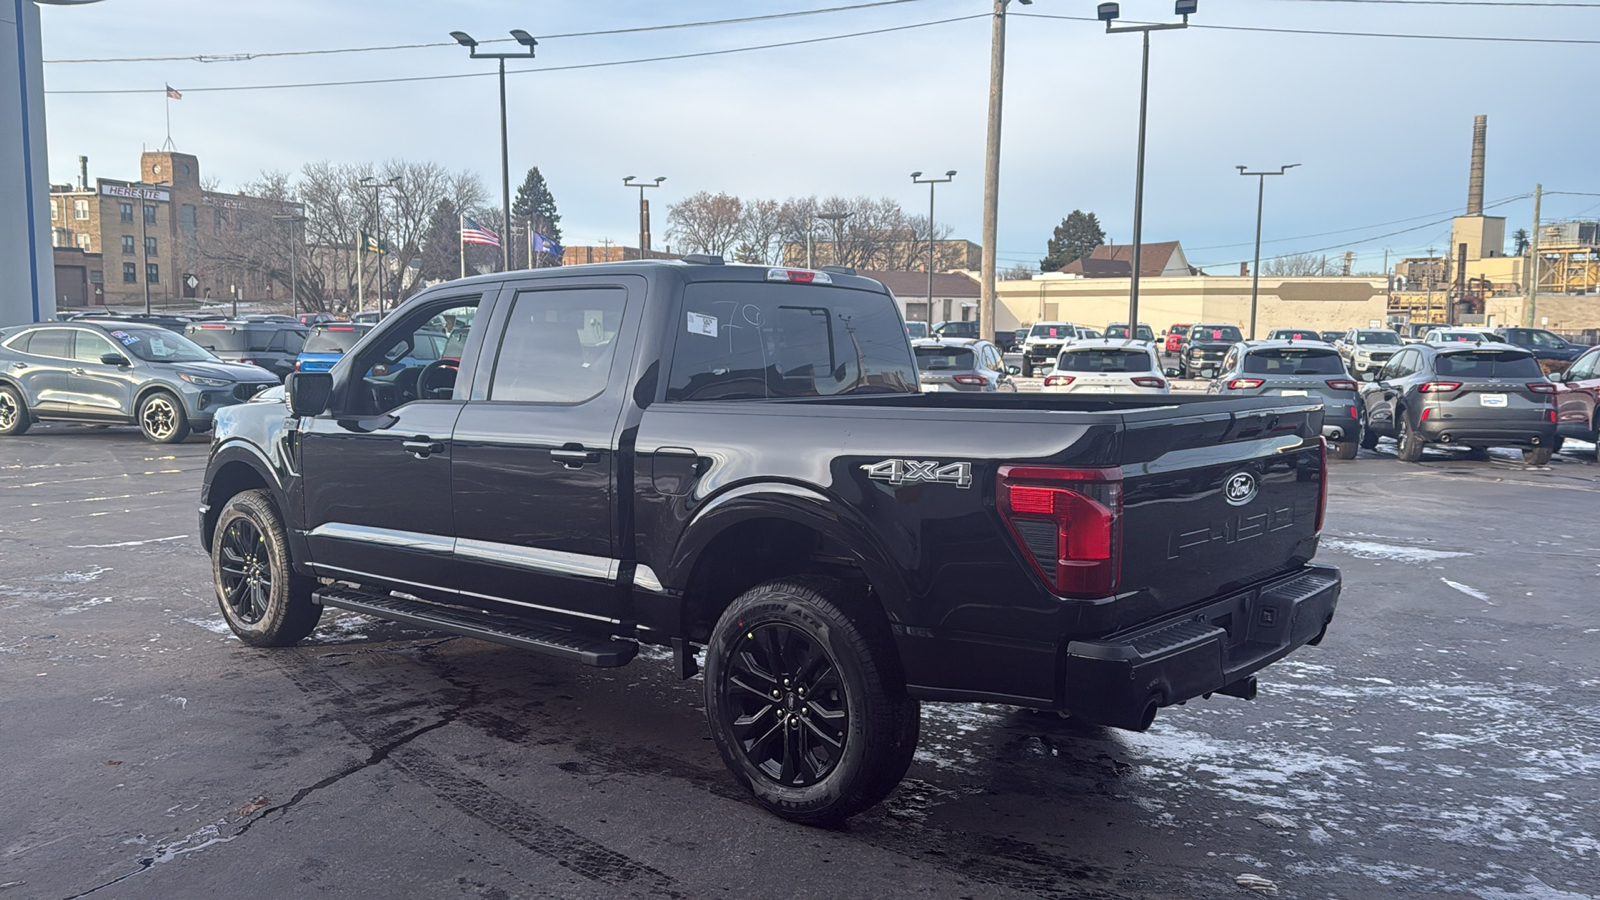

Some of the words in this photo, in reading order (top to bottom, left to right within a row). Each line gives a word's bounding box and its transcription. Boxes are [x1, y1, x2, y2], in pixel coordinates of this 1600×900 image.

[109, 186, 161, 200] HERESITE
[1230, 476, 1251, 498] Ford
[1167, 500, 1295, 560] F-150
